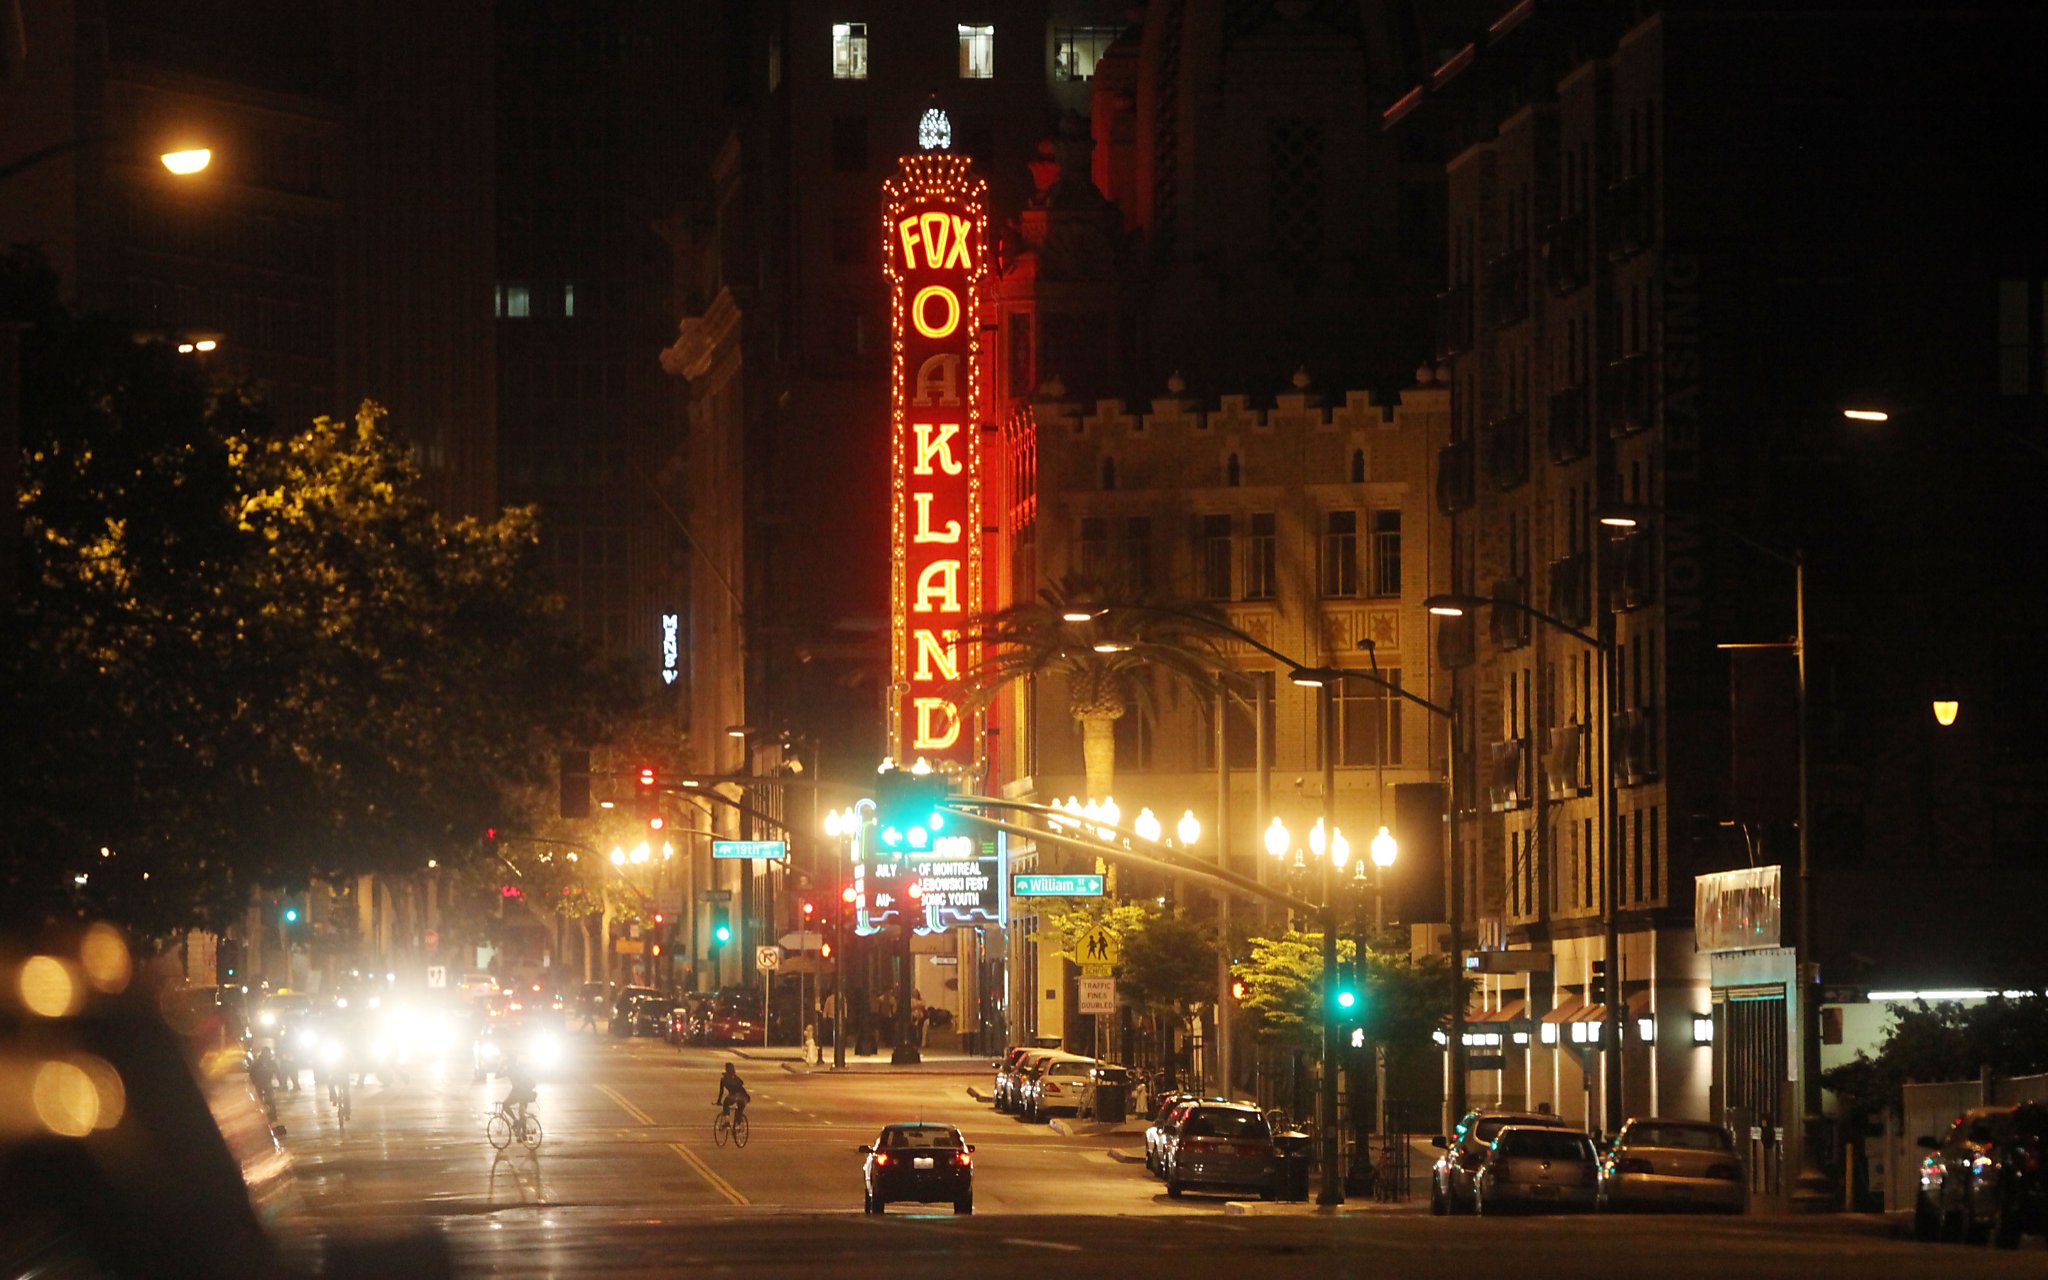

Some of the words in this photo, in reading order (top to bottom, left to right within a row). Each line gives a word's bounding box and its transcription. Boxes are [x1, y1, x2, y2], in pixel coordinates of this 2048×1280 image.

[899, 212, 972, 269] FOX
[912, 285, 963, 749] OAKLAND
[875, 863, 897, 877] JULY
[918, 862, 931, 876] OF
[932, 862, 981, 876] MONTREAL
[966, 877, 989, 891] FEST
[1030, 878, 1074, 892] William
[948, 892, 979, 906] YOUTH
[1084, 982, 1111, 990] TRAFFIC
[1087, 992, 1108, 1000] FINES
[1082, 1002, 1113, 1010] DOUBLED
